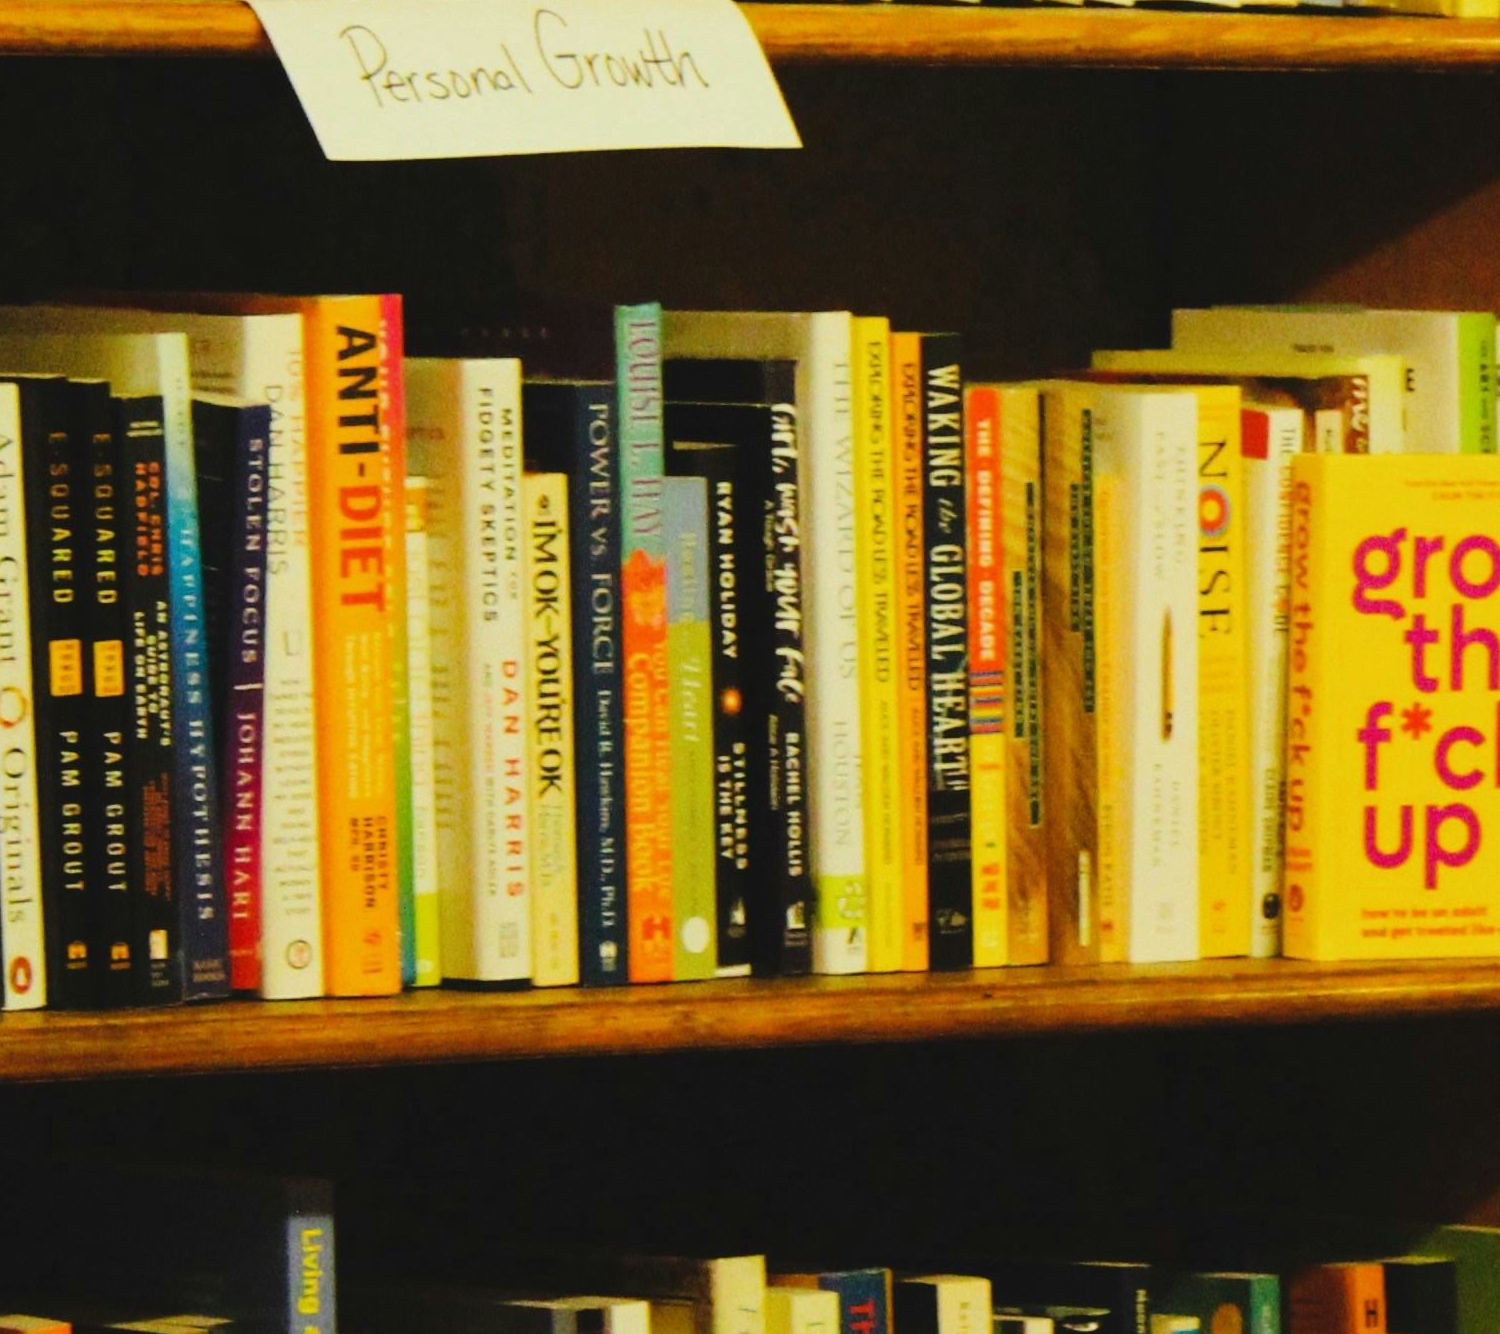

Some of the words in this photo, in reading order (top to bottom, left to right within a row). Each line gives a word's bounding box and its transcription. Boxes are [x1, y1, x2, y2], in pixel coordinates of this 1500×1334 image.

[339, 24, 533, 109] Personal
[535, 7, 709, 90] Growth
[335, 325, 386, 613] ANTI-DIET
[587, 403, 613, 519] POWER
[927, 364, 960, 487] WAKING
[243, 438, 265, 551] STOLEN
[717, 481, 733, 547] RYAN
[937, 497, 957, 535] the
[240, 567, 262, 665] FOCUS
[590, 572, 614, 676] FORCE
[719, 554, 737, 658] HOLIDAY
[930, 545, 963, 659] GLOBAL
[231, 713, 256, 832] JOHANN
[784, 732, 802, 805] RACHEL
[229, 847, 252, 921] HARI
[786, 811, 803, 876] HOLLIS
[1364, 804, 1482, 890] up
[299, 1229, 323, 1319] Living
